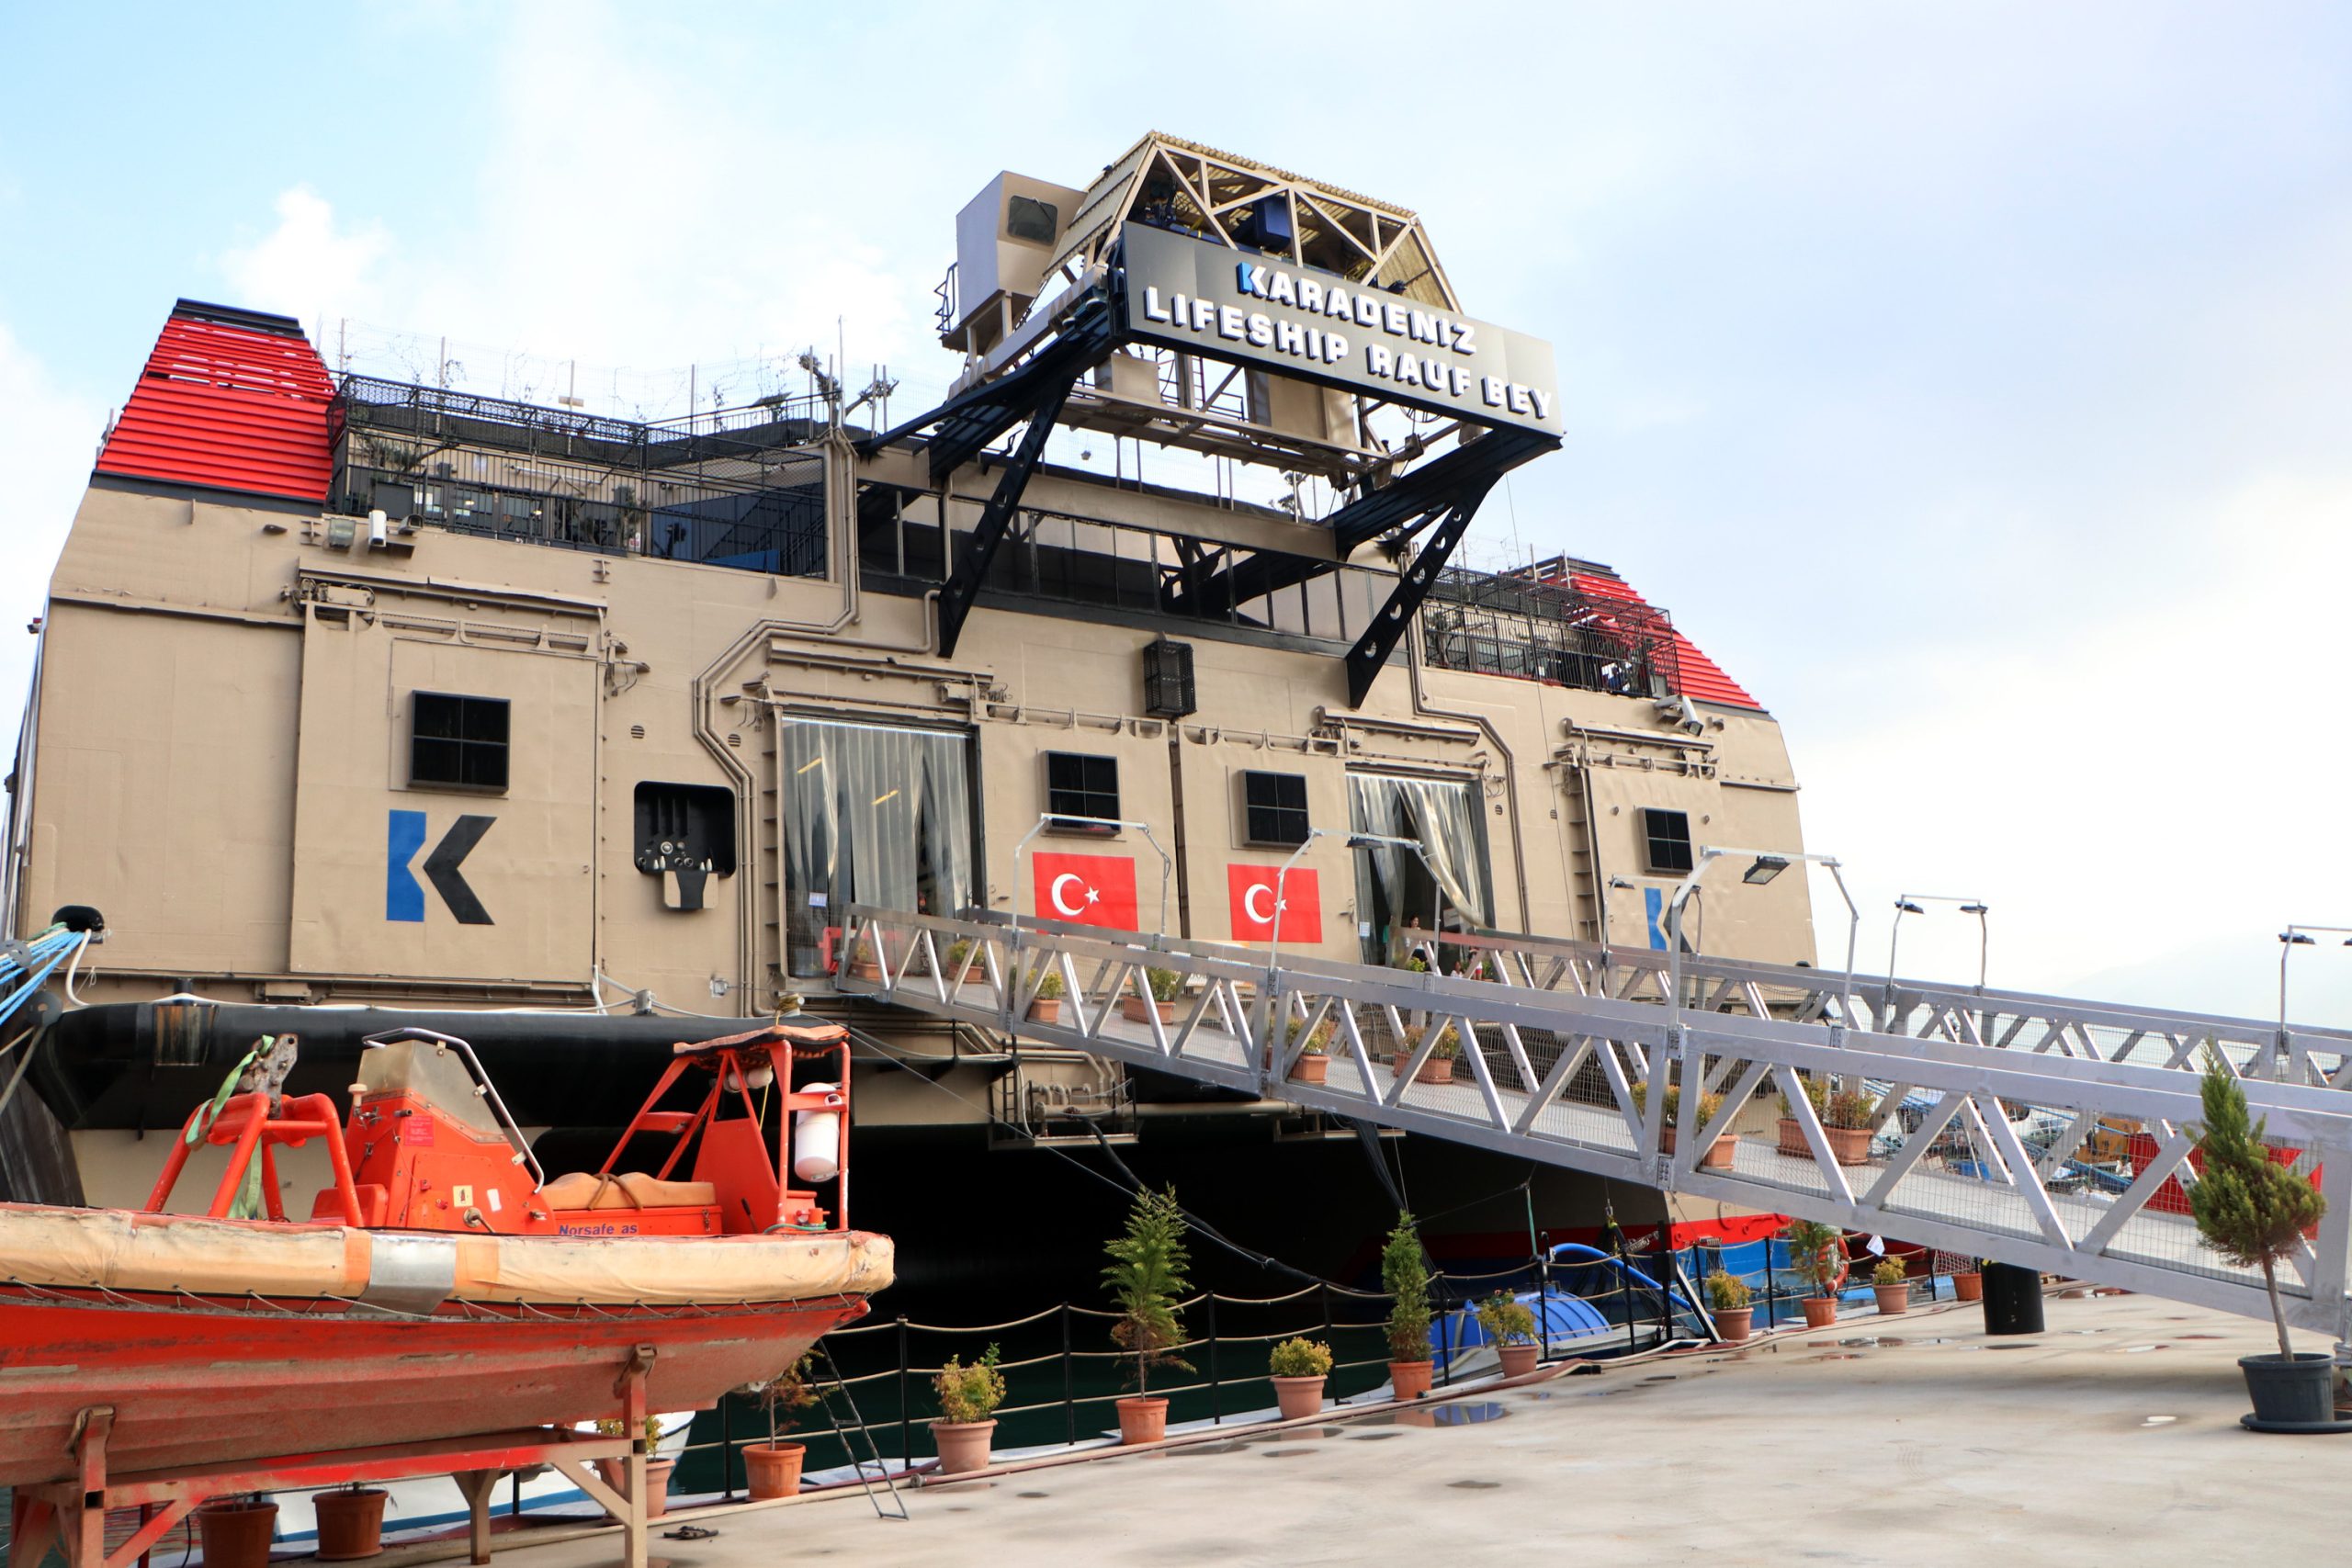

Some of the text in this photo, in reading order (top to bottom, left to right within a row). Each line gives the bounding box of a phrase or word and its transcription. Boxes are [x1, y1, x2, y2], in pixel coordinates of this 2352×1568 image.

[1144, 286, 1551, 418] LIFESHIP RAUF BEY
[1237, 262, 1476, 355] KARADENIZ
[386, 808, 498, 926] K
[560, 1223, 639, 1235] Norsafe as
